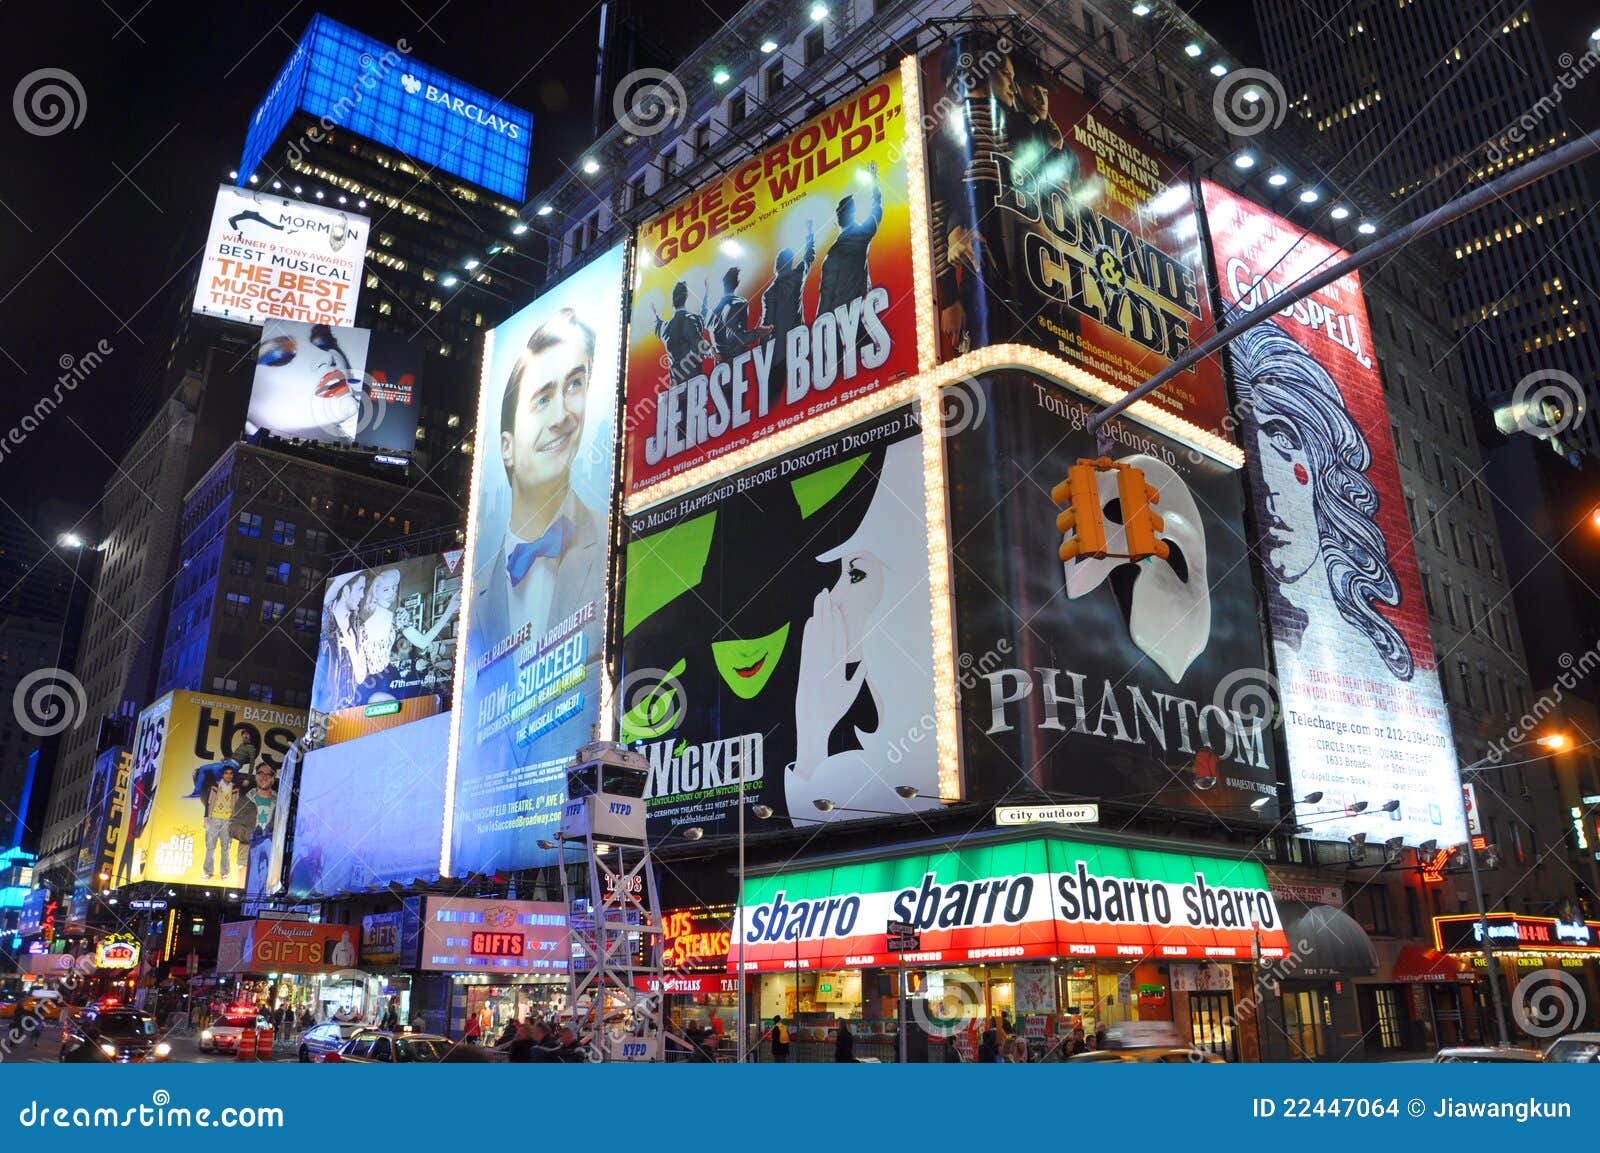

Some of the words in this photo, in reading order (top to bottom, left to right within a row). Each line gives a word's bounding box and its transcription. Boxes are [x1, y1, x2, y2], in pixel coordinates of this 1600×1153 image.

[425, 85, 520, 140] BARCLAYS
[735, 83, 892, 194] CROWD
[1074, 124, 1116, 164] MOST
[653, 190, 757, 268] GOES
[219, 244, 265, 262] BEST
[271, 255, 351, 281] MUSICAL
[222, 234, 267, 250] WINNER
[280, 246, 308, 259] TONY
[309, 253, 353, 268] AWARDS
[210, 291, 251, 310] THIS
[211, 276, 311, 308] MUSICAL
[316, 298, 347, 315] OF
[278, 270, 349, 300] BEST
[1024, 232, 1197, 376] CLYDE
[645, 339, 775, 466] JERSEY
[786, 286, 891, 405] BOYS
[777, 412, 805, 429] West
[807, 397, 838, 416] 52nd
[840, 379, 880, 401] Street
[1033, 383, 1090, 432] Tonigh
[680, 485, 734, 516] HAPPENED
[737, 467, 778, 493] BEFORE
[781, 442, 839, 476] DOROTHY
[842, 420, 900, 453] DROPPED
[389, 679, 405, 689] 47th
[479, 682, 509, 728] HOW
[517, 631, 588, 700] SUCCEED
[243, 706, 308, 729] BAZINGA!
[982, 667, 1270, 770] PHANTOM
[1289, 710, 1371, 734] Telecharge.com
[1375, 726, 1385, 739] or
[194, 706, 297, 769] tbs
[716, 785, 741, 796] WITCHE
[609, 802, 632, 816] NYPD
[1010, 809, 1033, 821] city
[1038, 808, 1087, 819] outdoor
[144, 902, 166, 910] Wgner
[747, 890, 861, 944] sbarro
[893, 873, 1034, 931] sbarro
[1058, 863, 1171, 925] sbarro
[1182, 875, 1274, 929] sbarro
[257, 940, 322, 963] GIFTS
[370, 926, 397, 945] GIFTS
[473, 933, 522, 954] GIFTS
[675, 931, 731, 966] STEAKS
[1070, 944, 1096, 955] PIZZA
[1117, 946, 1144, 955] PASTA
[1162, 946, 1188, 956] SALAD
[845, 954, 875, 965] SALAD
[967, 947, 1024, 959] ESPRESSO
[1518, 958, 1543, 967] CHICKEN
[675, 979, 703, 991] STEAKS
[623, 1043, 647, 1057] NYPD
